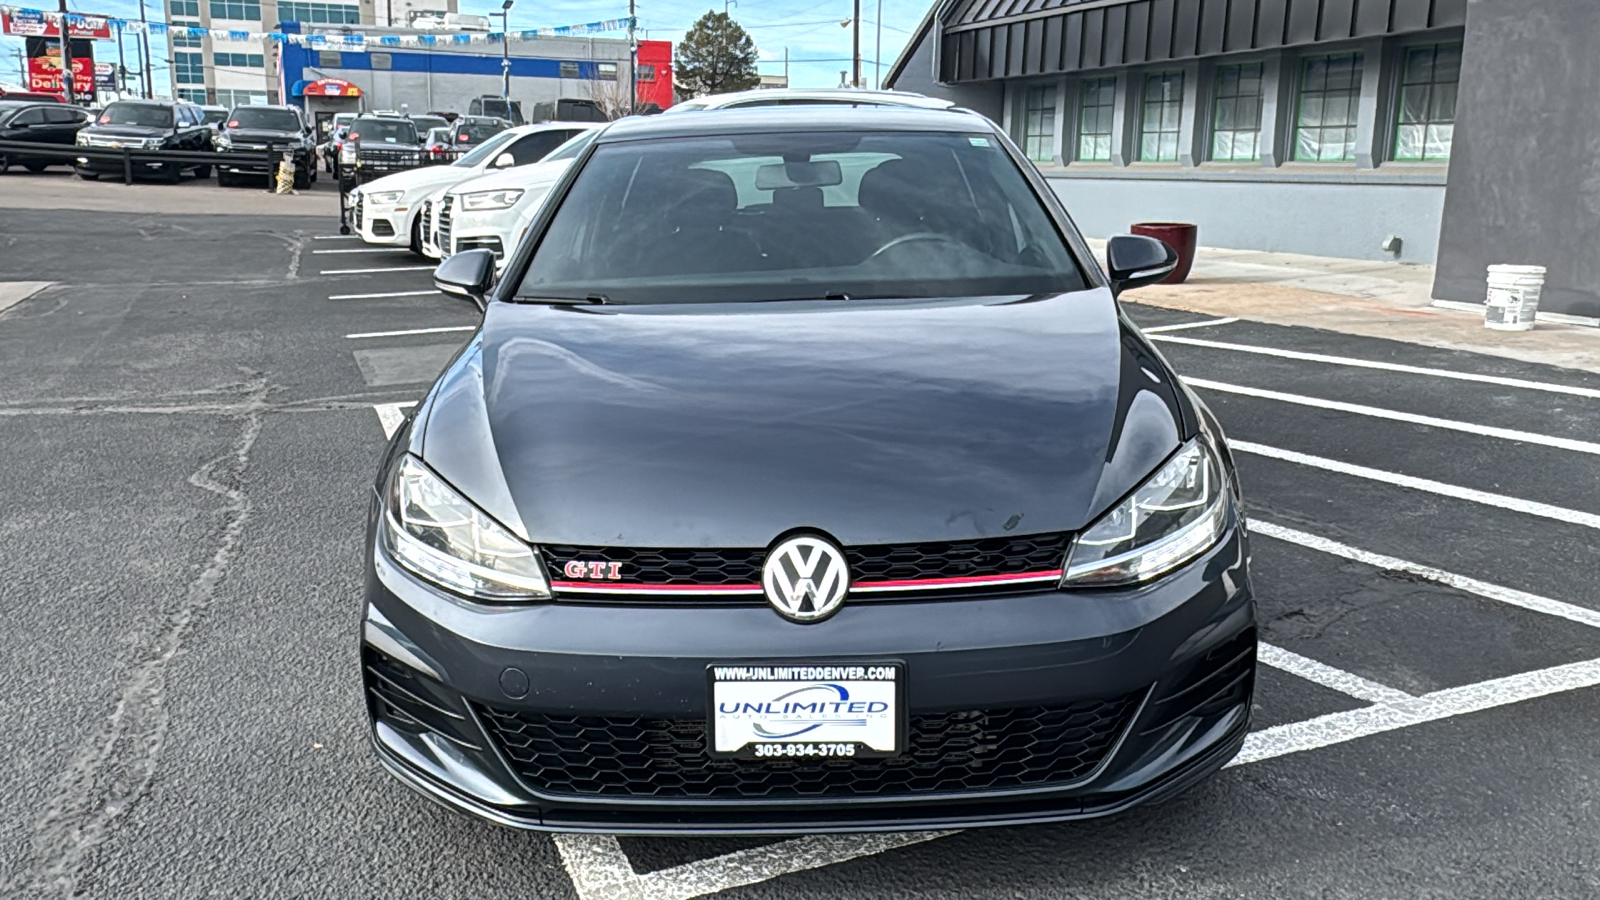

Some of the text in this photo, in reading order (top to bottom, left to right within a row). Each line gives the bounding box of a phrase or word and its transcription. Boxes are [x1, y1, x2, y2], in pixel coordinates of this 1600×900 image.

[564, 560, 622, 580] GTI
[714, 667, 896, 681] WWW.UNLIMITEDDENVER.COM
[719, 701, 889, 714] UNLIMITED
[754, 744, 856, 757] 303-934-3705
